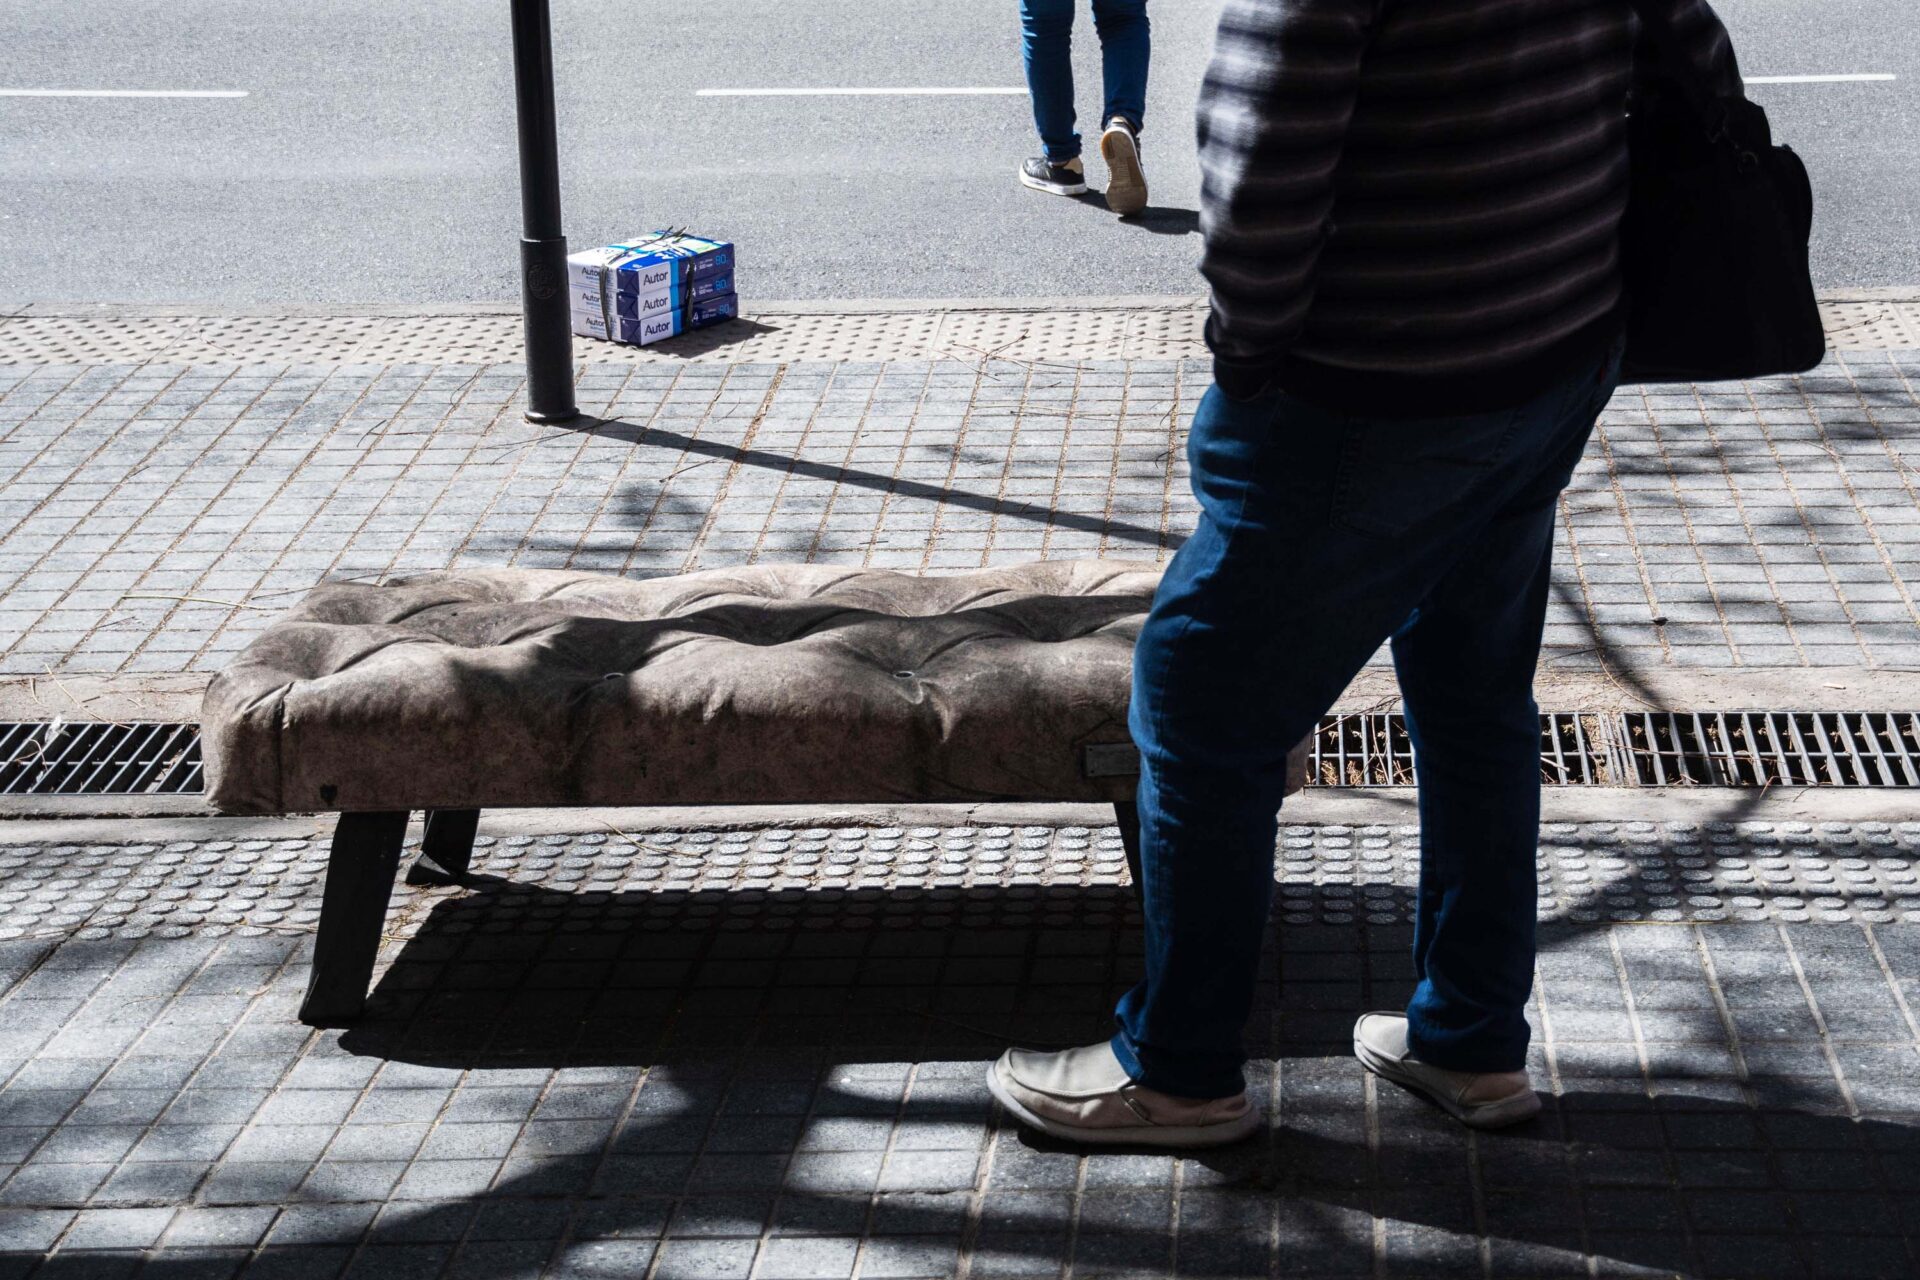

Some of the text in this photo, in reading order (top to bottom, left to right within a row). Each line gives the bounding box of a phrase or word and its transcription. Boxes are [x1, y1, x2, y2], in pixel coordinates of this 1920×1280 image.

[581, 267, 601, 277] Auto
[643, 271, 669, 286] Autor
[643, 297, 669, 312] Autor
[644, 321, 671, 337] Autor
